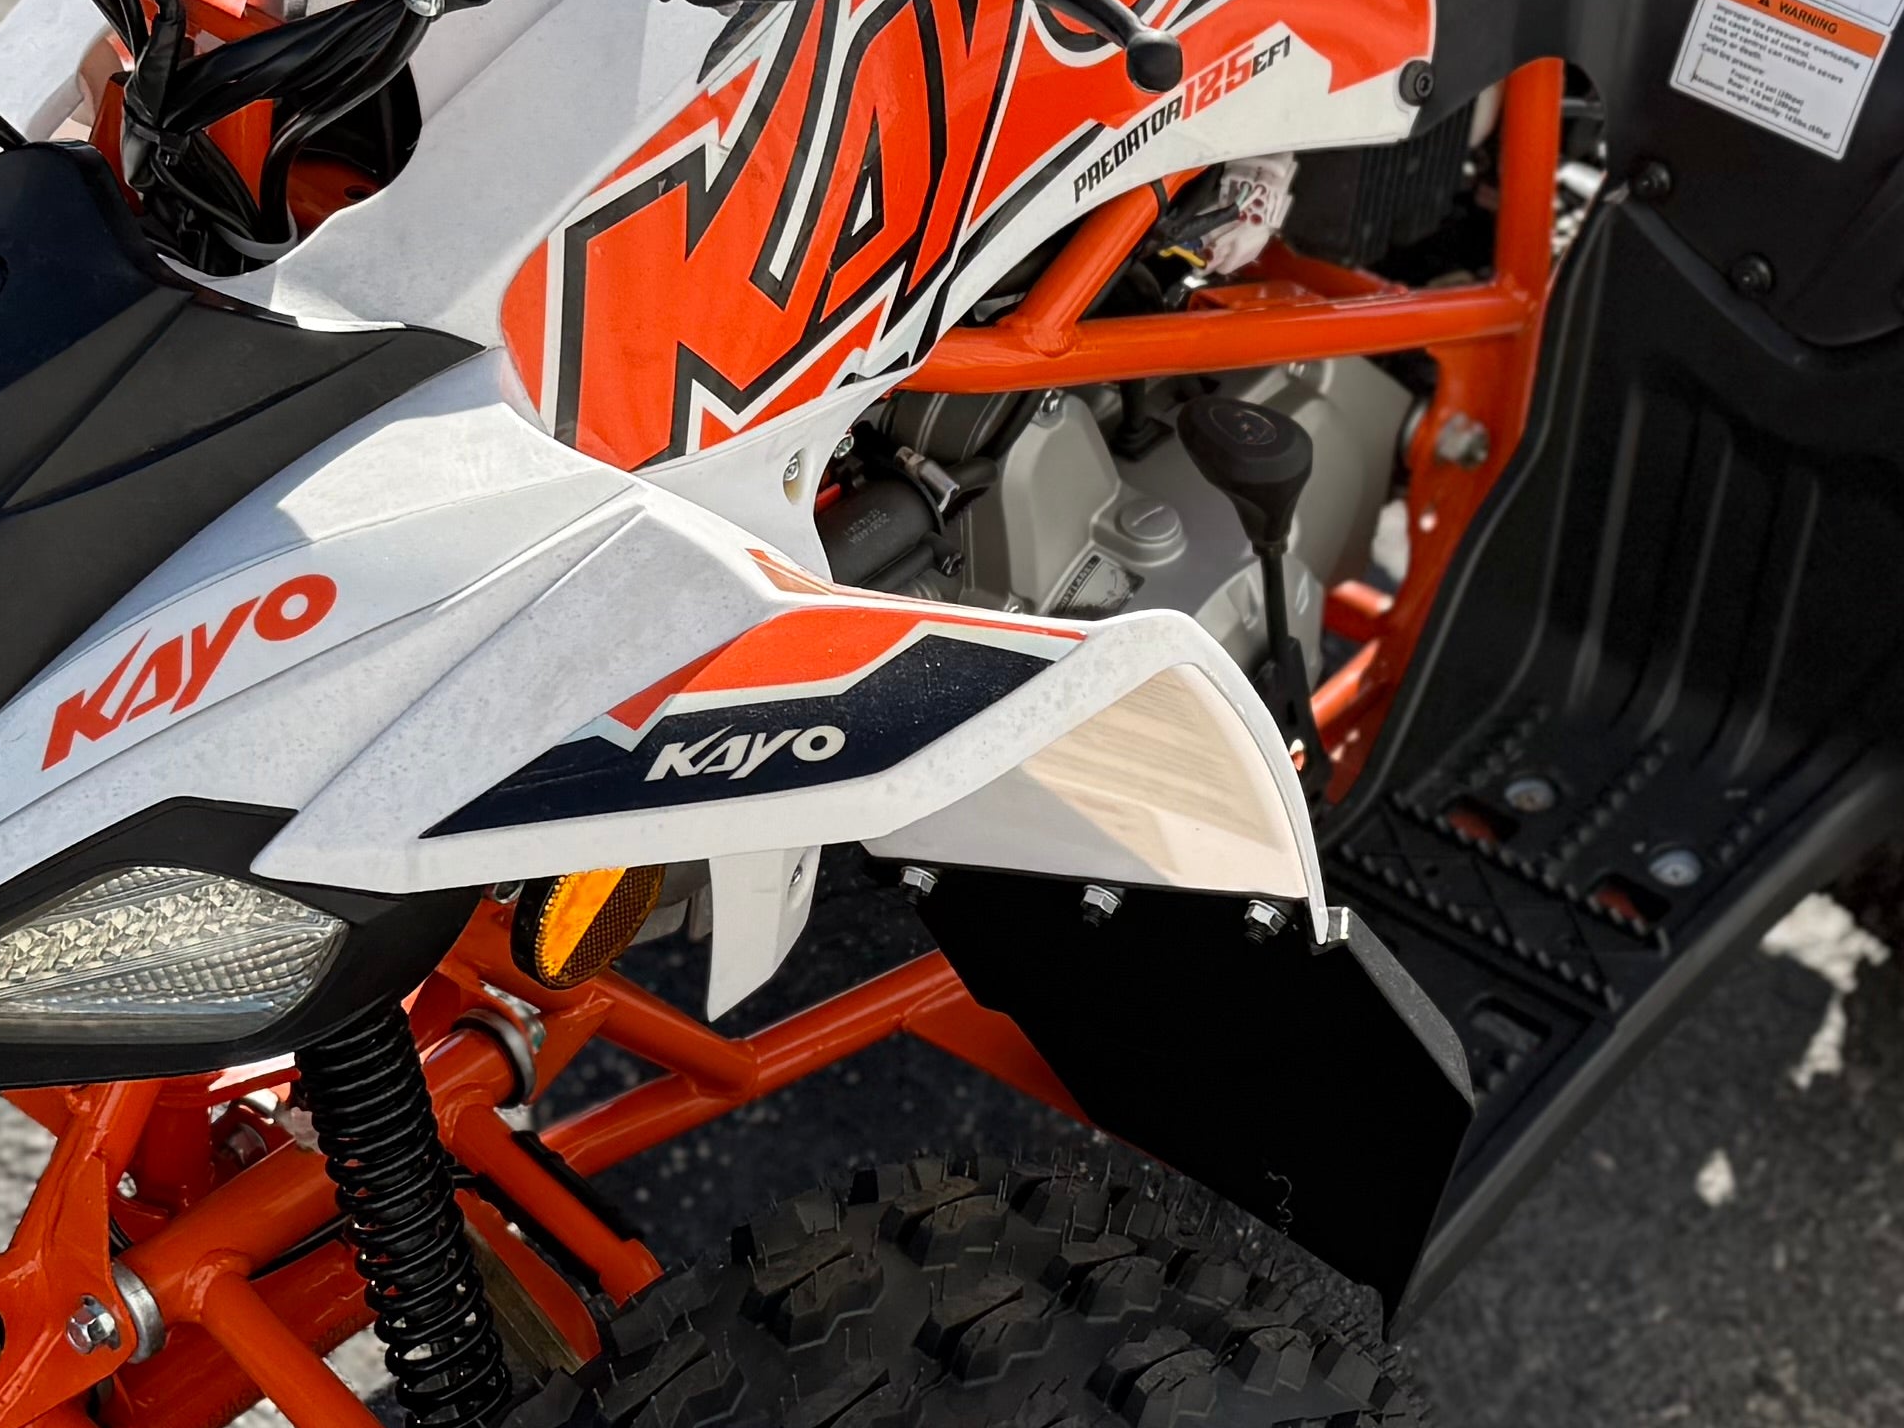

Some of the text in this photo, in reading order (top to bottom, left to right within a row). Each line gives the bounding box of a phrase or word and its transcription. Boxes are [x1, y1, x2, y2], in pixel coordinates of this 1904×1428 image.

[1728, 21, 1751, 34] cause
[1779, 1, 1838, 35] WARNING
[1739, 35, 1767, 51] control
[41, 573, 339, 771] KAYO
[643, 724, 847, 782] KAYO
